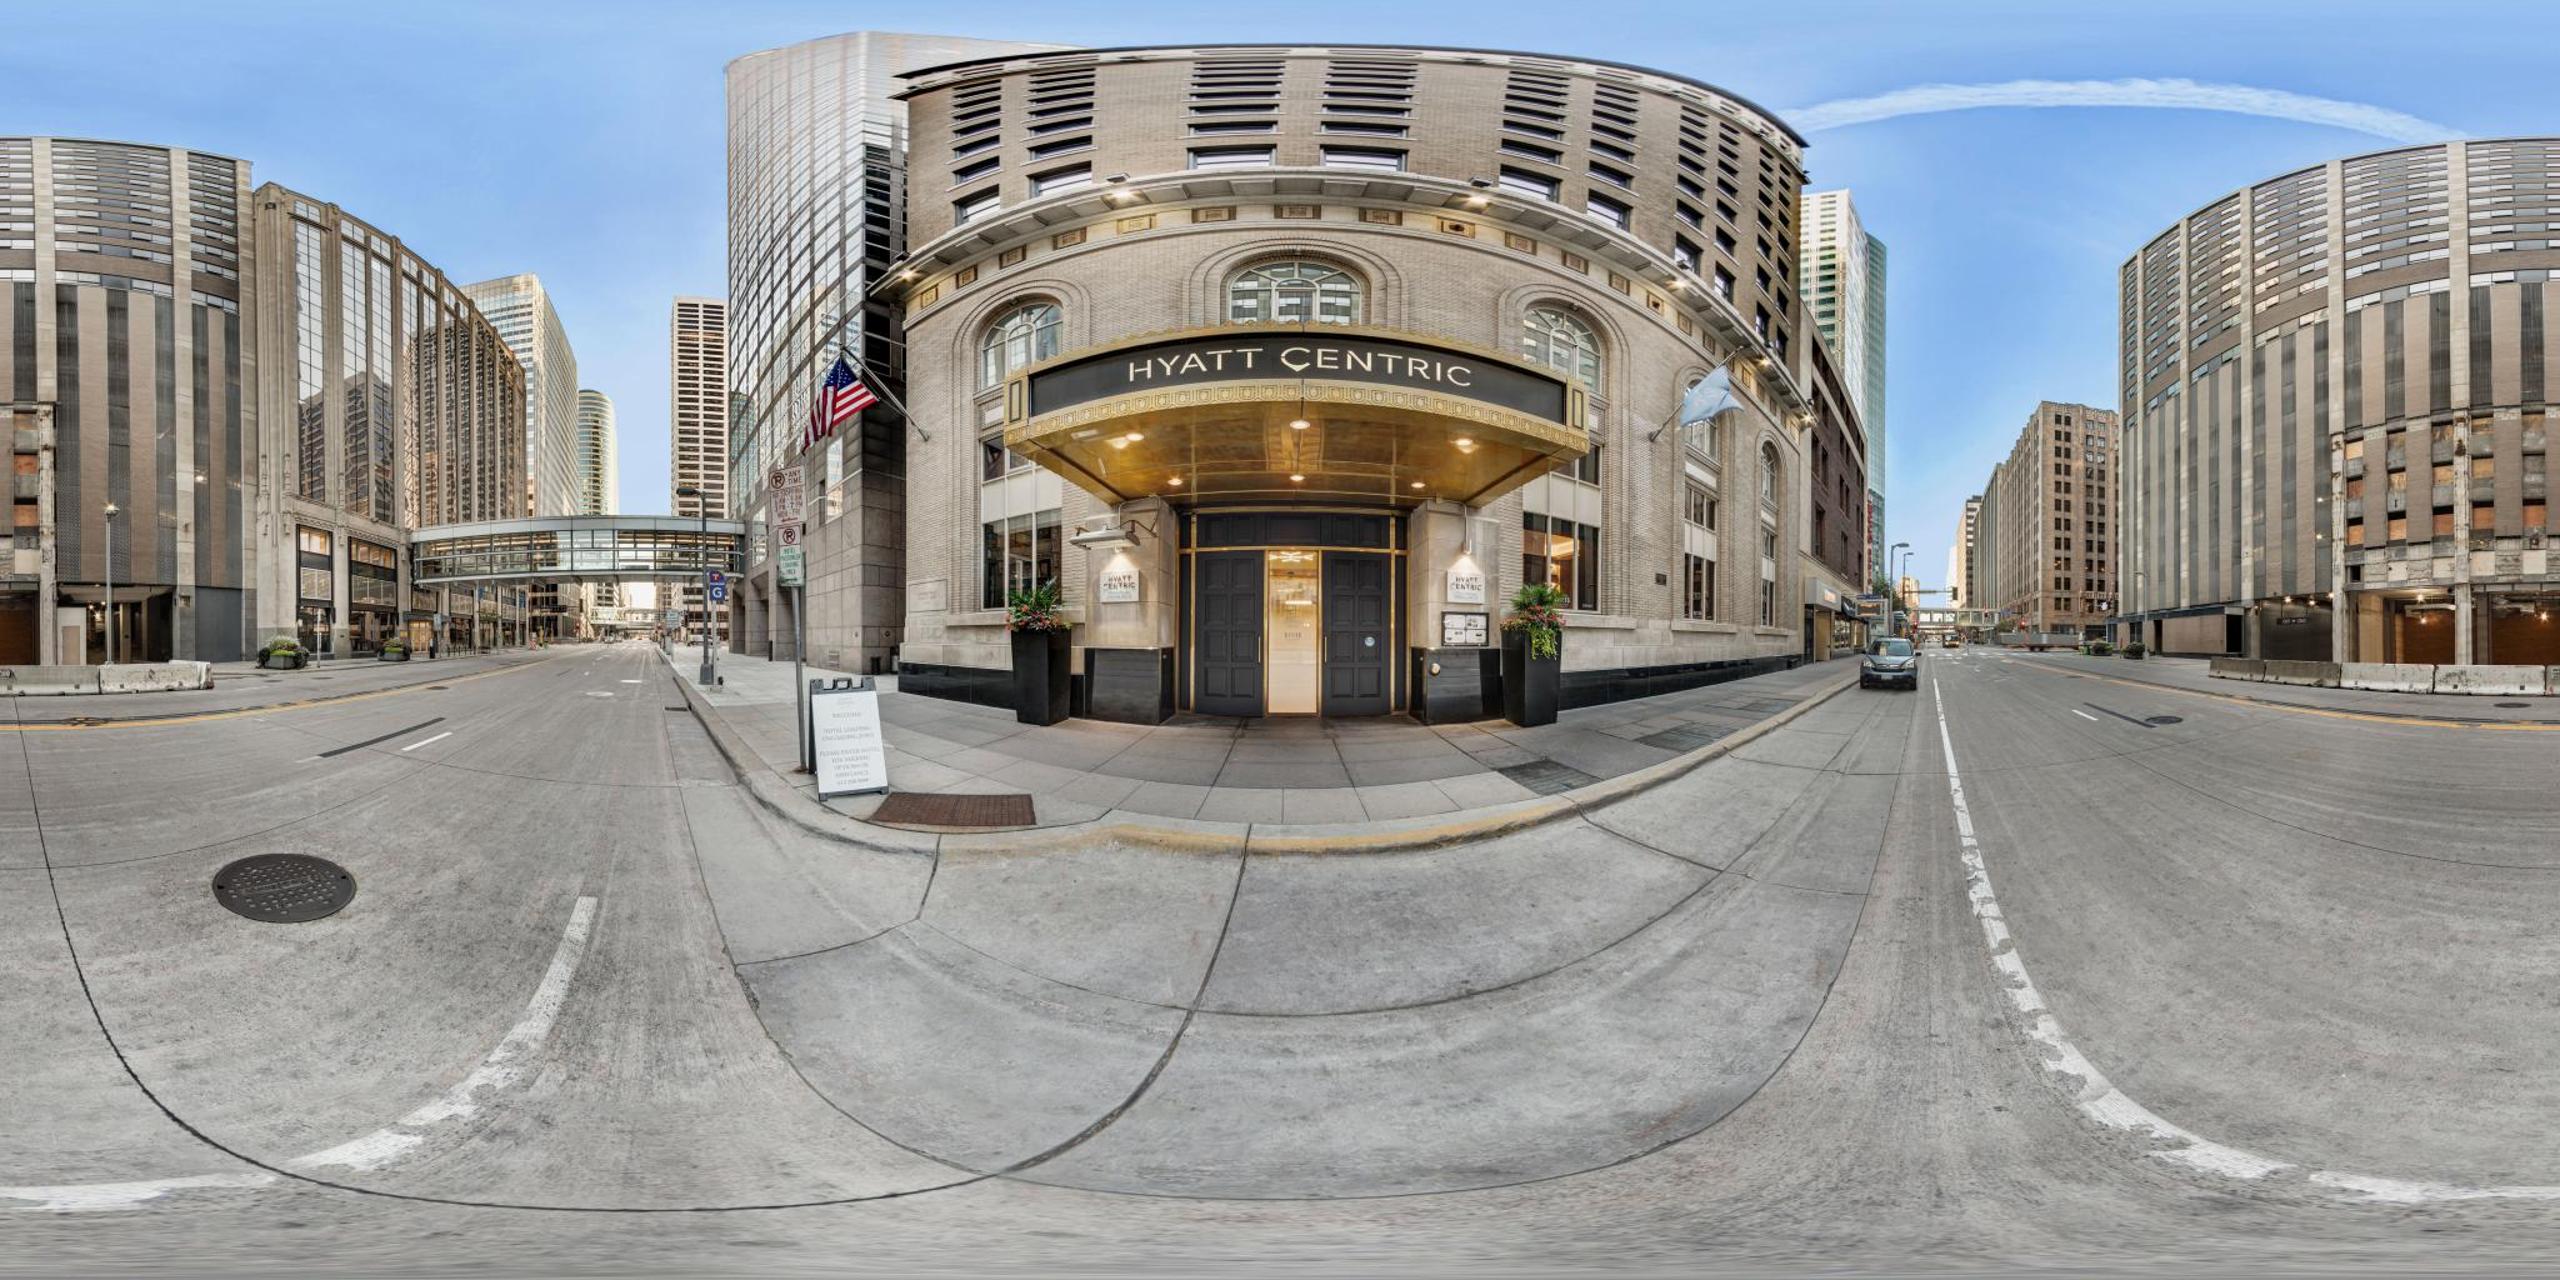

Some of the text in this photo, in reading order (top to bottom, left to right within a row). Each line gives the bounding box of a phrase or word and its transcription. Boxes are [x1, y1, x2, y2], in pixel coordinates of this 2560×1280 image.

[1128, 347, 1472, 388] HYATT CENTRIC
[712, 586, 722, 599] G
